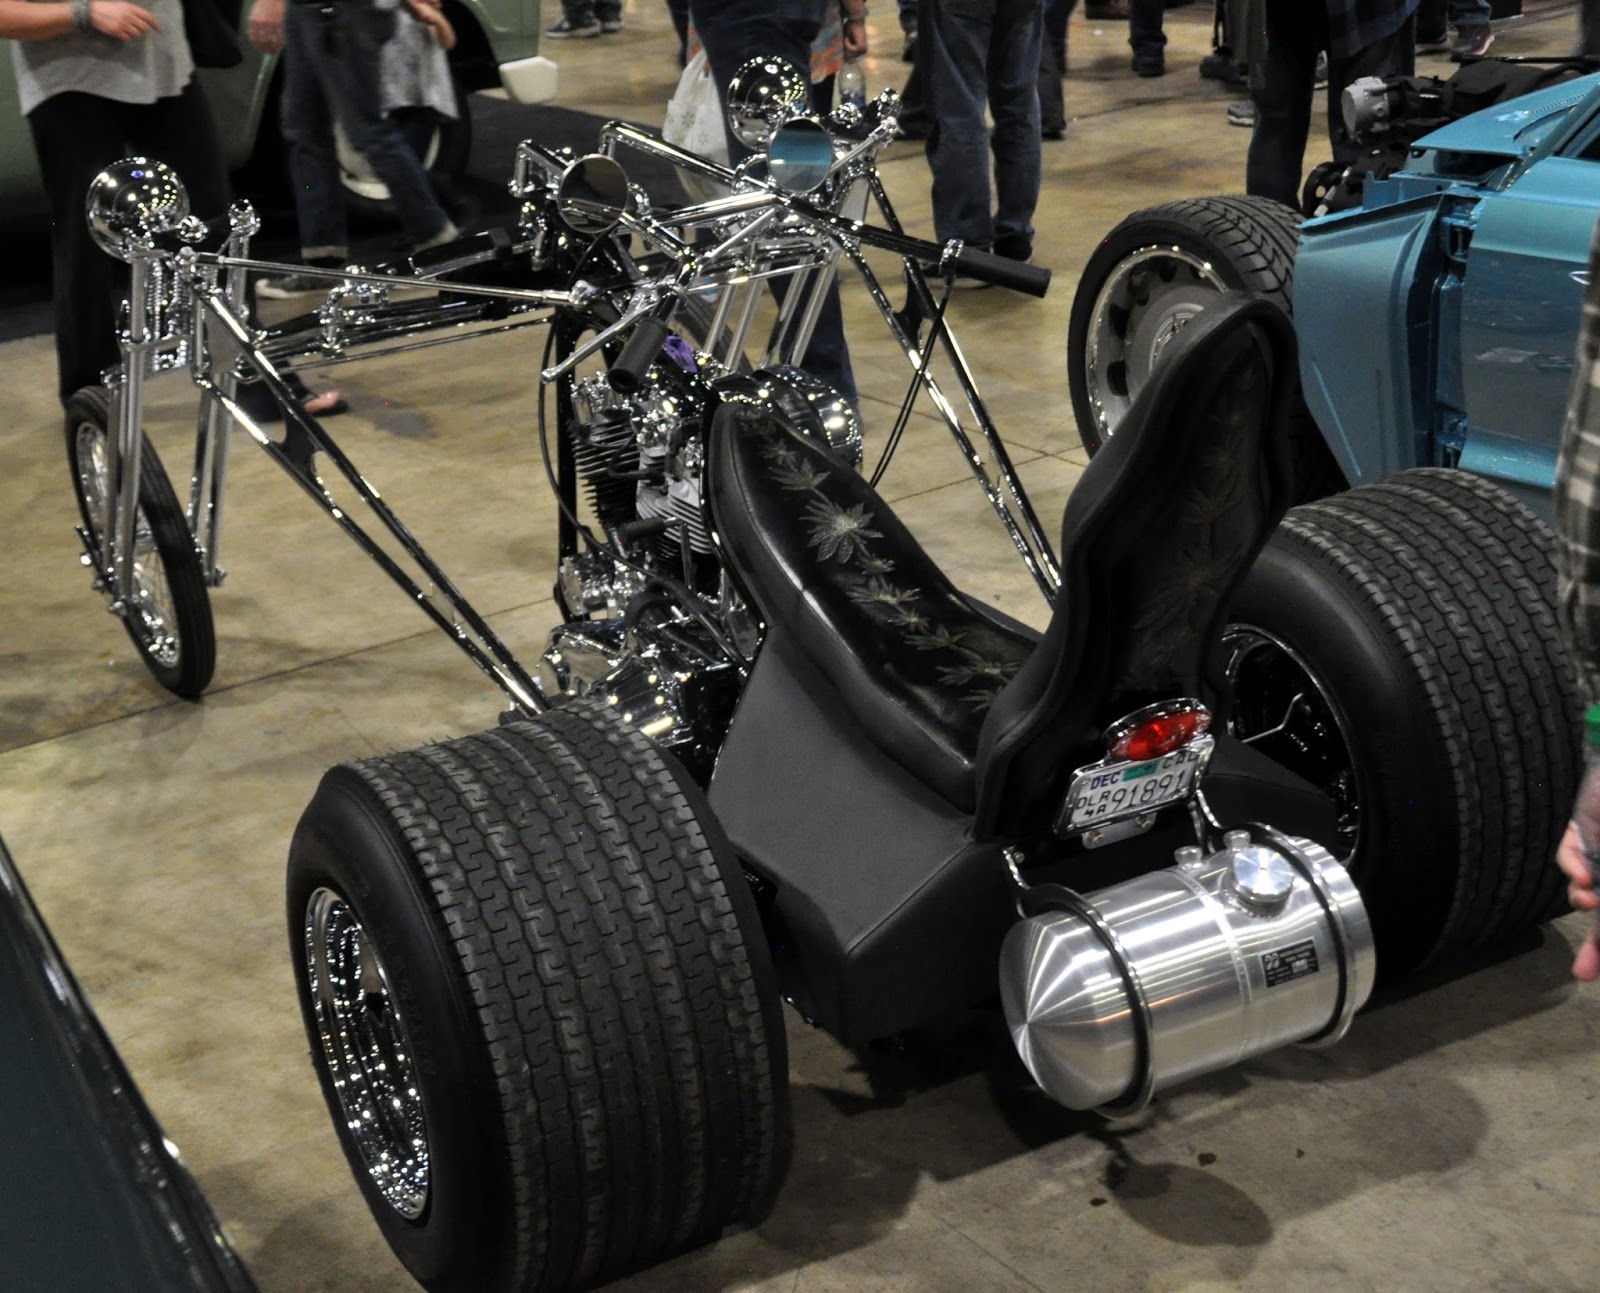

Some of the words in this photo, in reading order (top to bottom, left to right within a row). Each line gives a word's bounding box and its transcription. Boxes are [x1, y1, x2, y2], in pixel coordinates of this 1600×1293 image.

[1091, 772, 1120, 790] DEC
[1077, 791, 1109, 809] DLR
[1112, 773, 1184, 811] 91891
